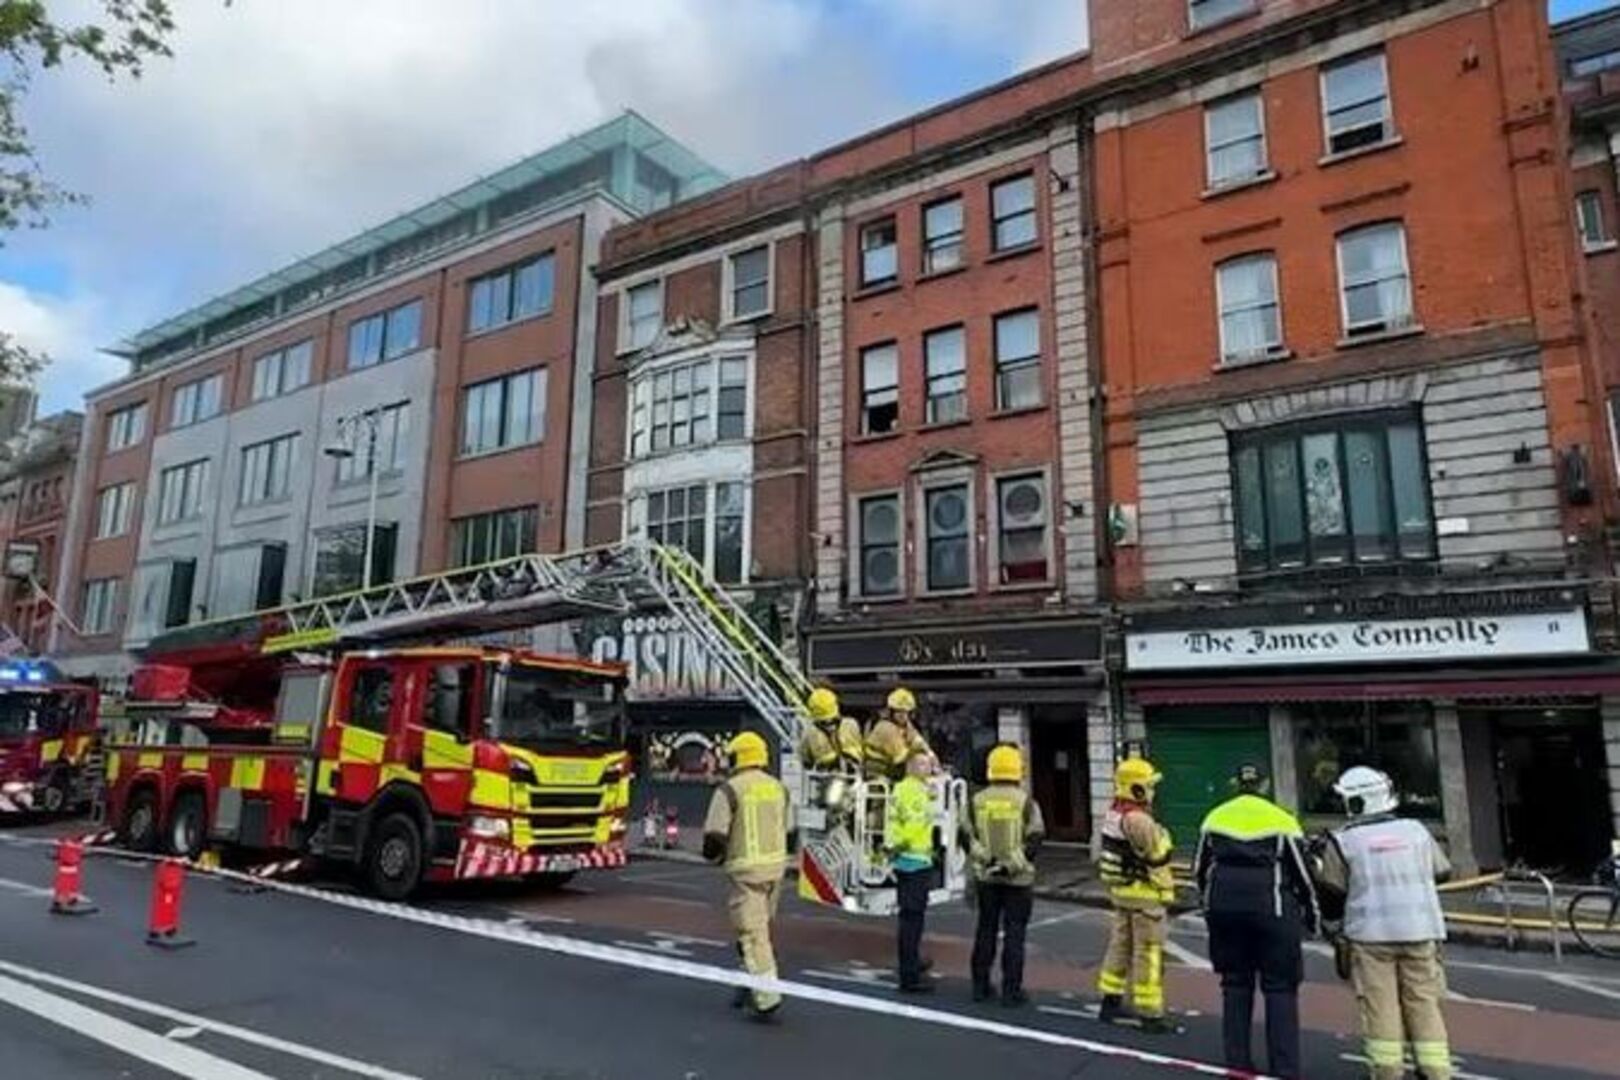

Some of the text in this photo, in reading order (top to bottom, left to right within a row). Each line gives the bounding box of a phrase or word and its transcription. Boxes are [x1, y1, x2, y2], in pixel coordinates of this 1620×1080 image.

[1184, 620, 1499, 655] The James Connolly
